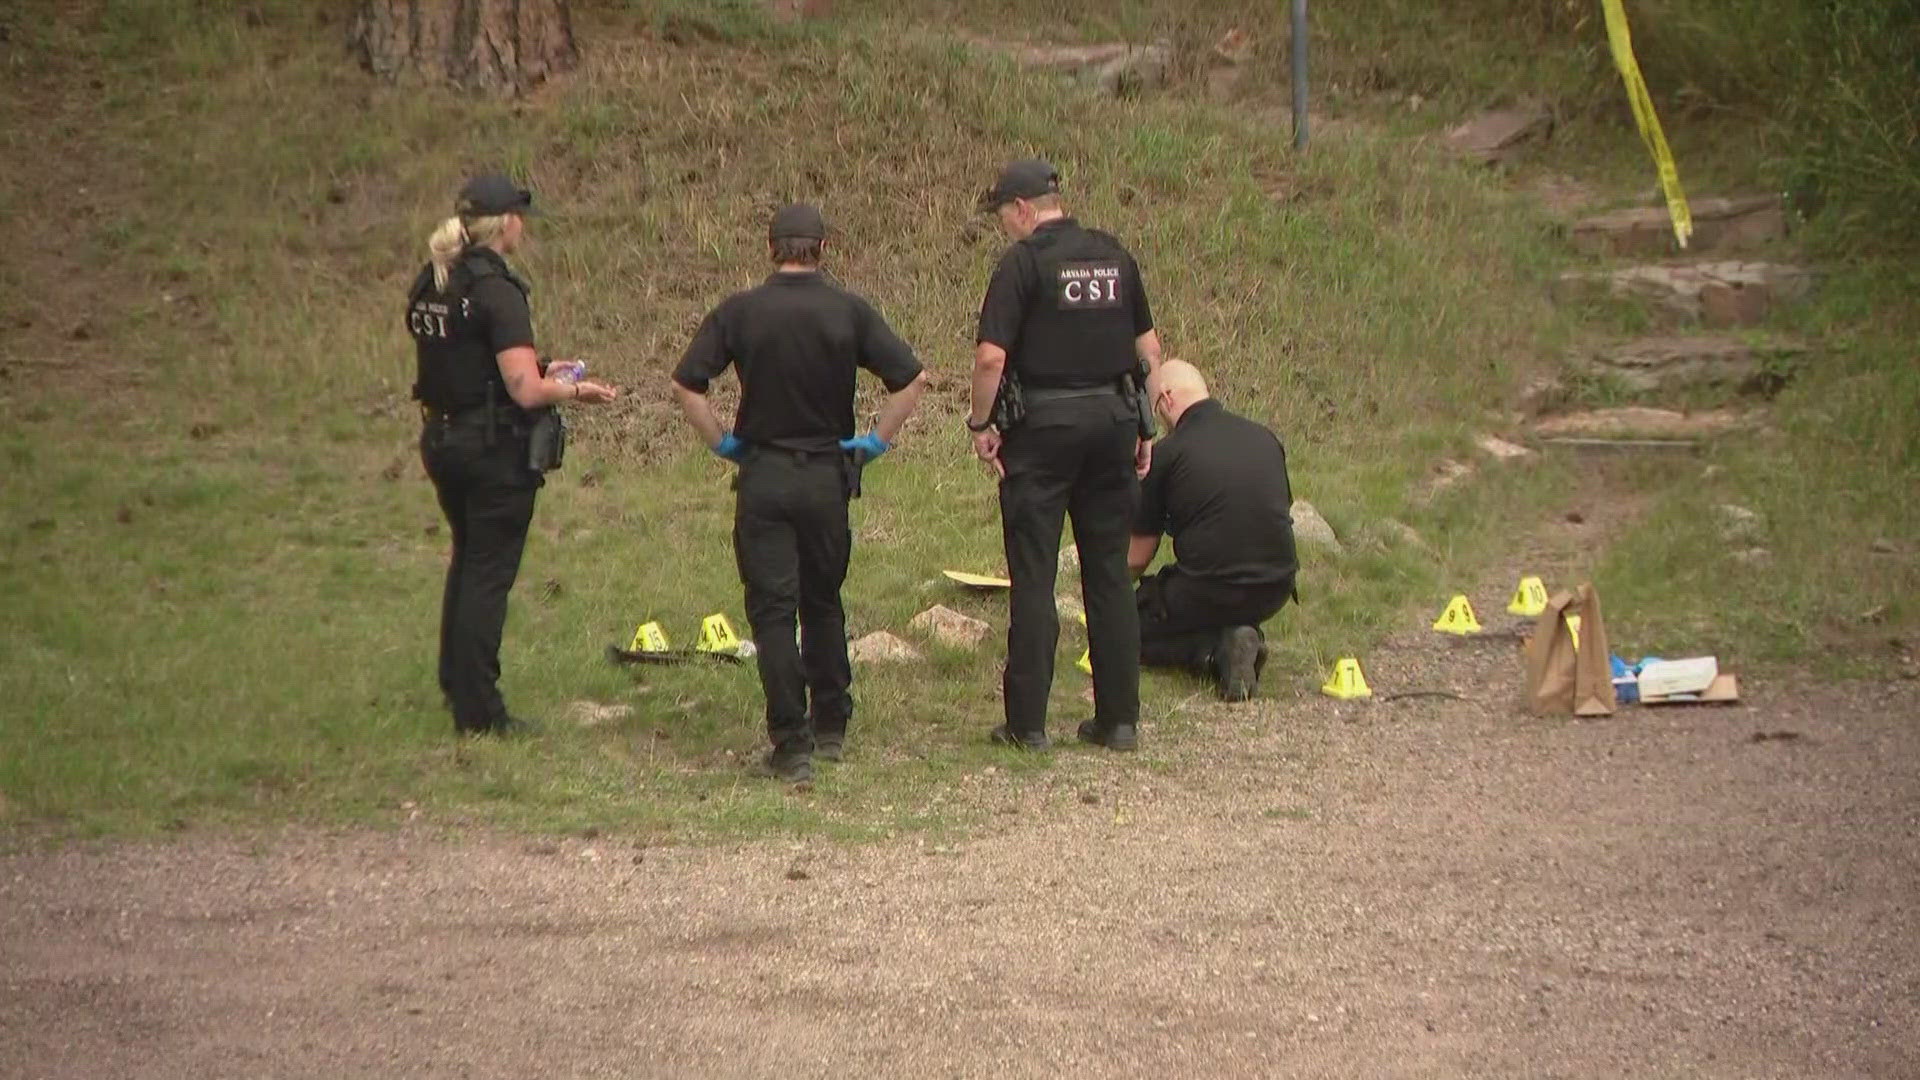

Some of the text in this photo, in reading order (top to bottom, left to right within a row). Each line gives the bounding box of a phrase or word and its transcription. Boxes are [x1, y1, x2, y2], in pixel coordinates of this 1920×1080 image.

[1061, 267, 1119, 279] ARVADA POLICE
[1065, 279, 1116, 302] CSI
[411, 310, 446, 338] CSI
[1530, 585, 1544, 604] 10
[1448, 609, 1456, 623] 9
[648, 630, 662, 651] 15
[711, 622, 728, 642] 14
